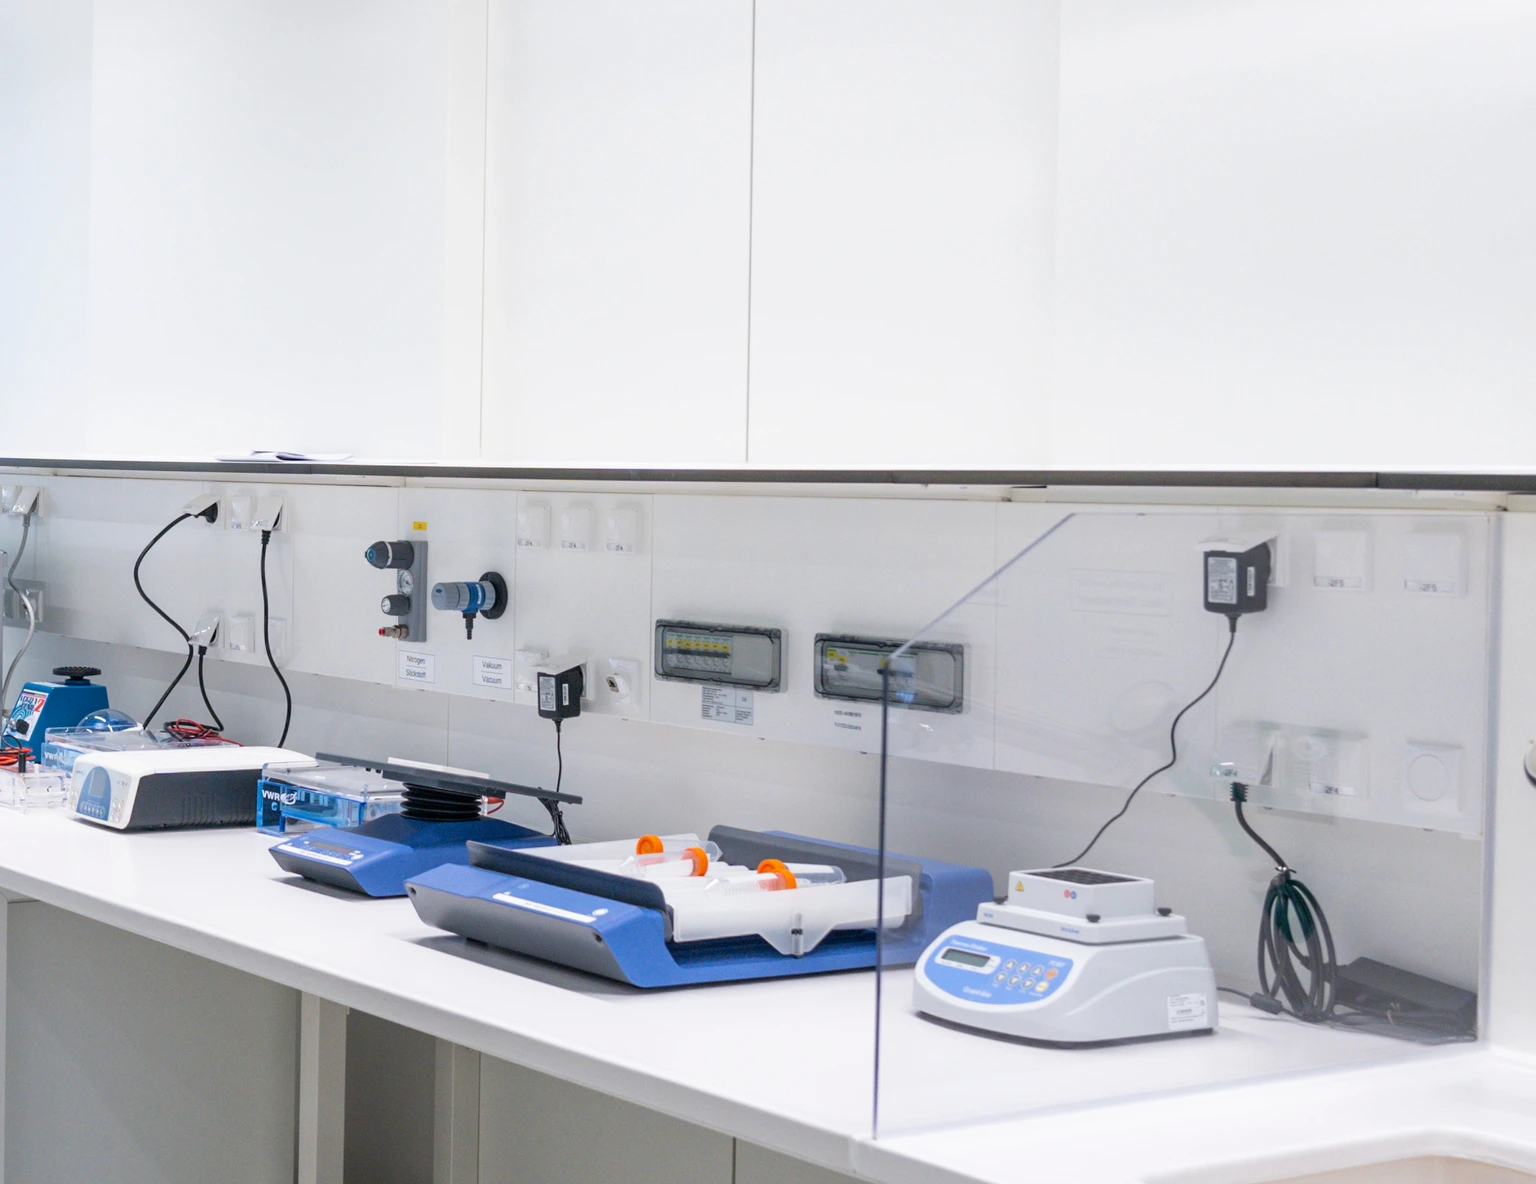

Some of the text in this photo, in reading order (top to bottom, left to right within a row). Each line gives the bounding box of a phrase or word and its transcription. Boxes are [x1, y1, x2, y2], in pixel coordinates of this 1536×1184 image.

[406, 655, 425, 665] Nitrogen
[482, 661, 502, 670] Vakuum
[482, 675, 502, 685] Vacuum
[261, 789, 280, 801] VWR
